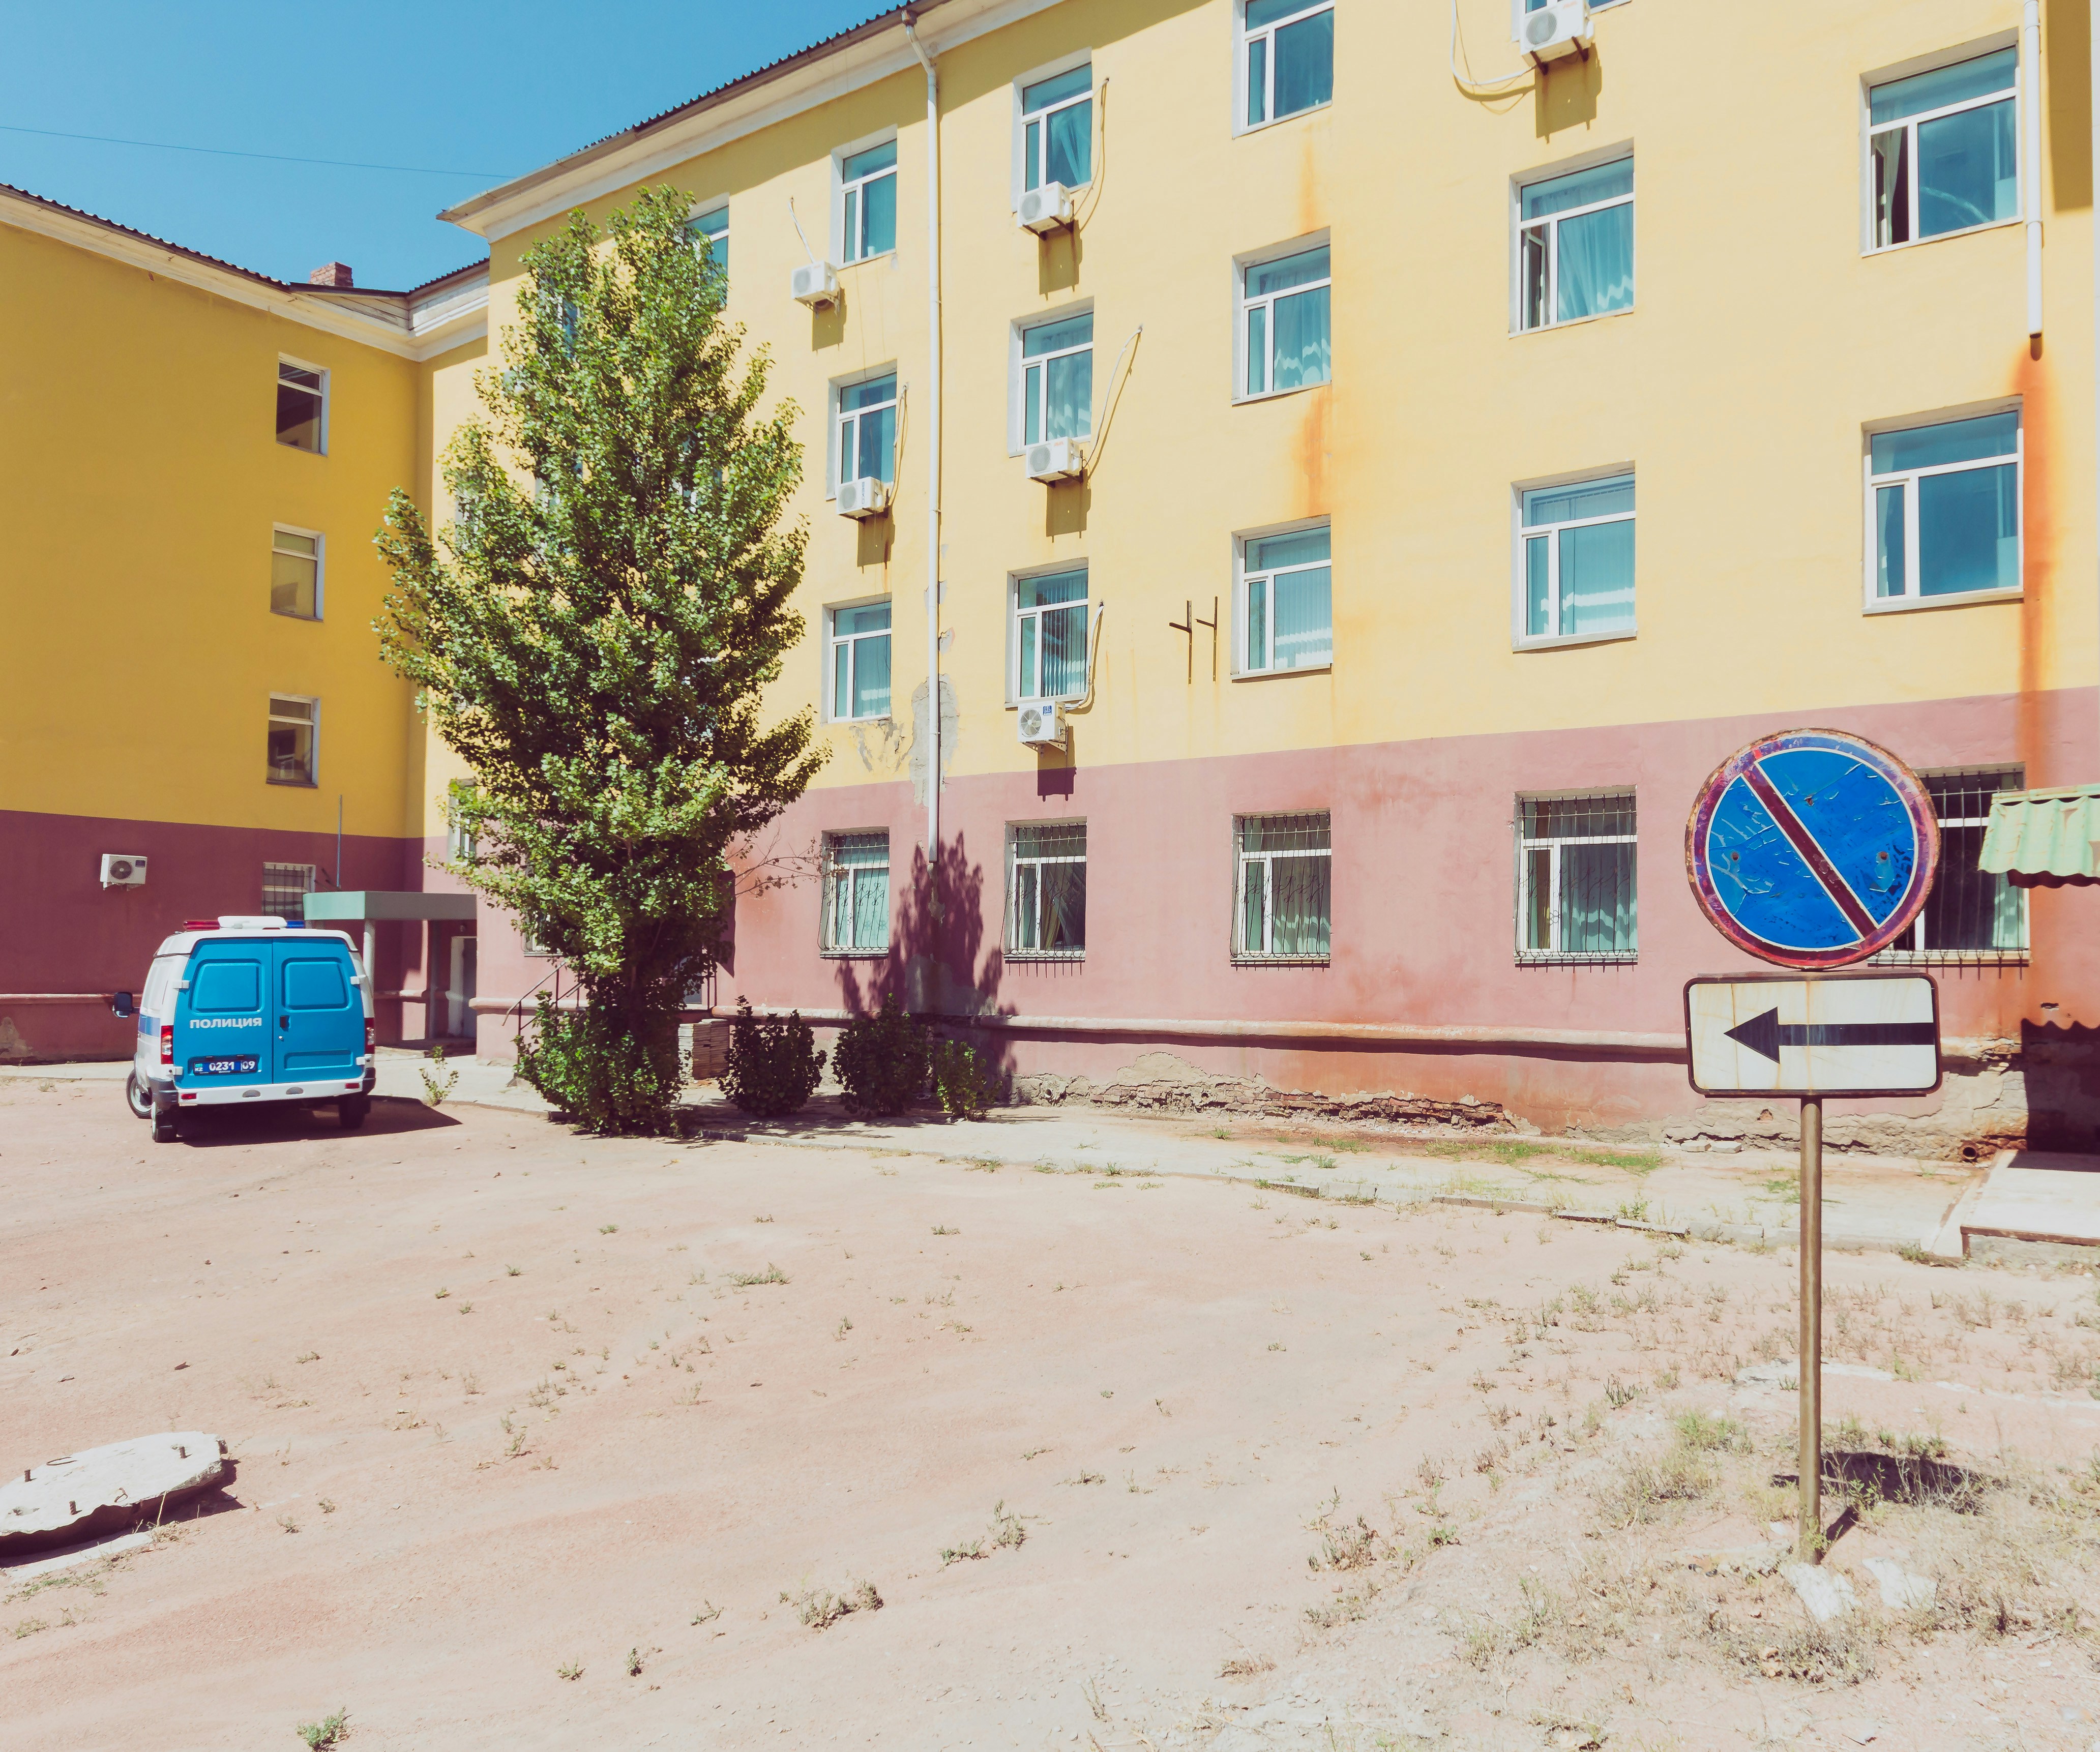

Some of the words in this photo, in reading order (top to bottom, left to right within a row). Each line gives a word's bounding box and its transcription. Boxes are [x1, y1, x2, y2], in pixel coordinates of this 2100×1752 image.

[190, 1018, 262, 1028] ПОЛИЦИЯ
[209, 1061, 234, 1071] 0231
[242, 1061, 255, 1070] 09
